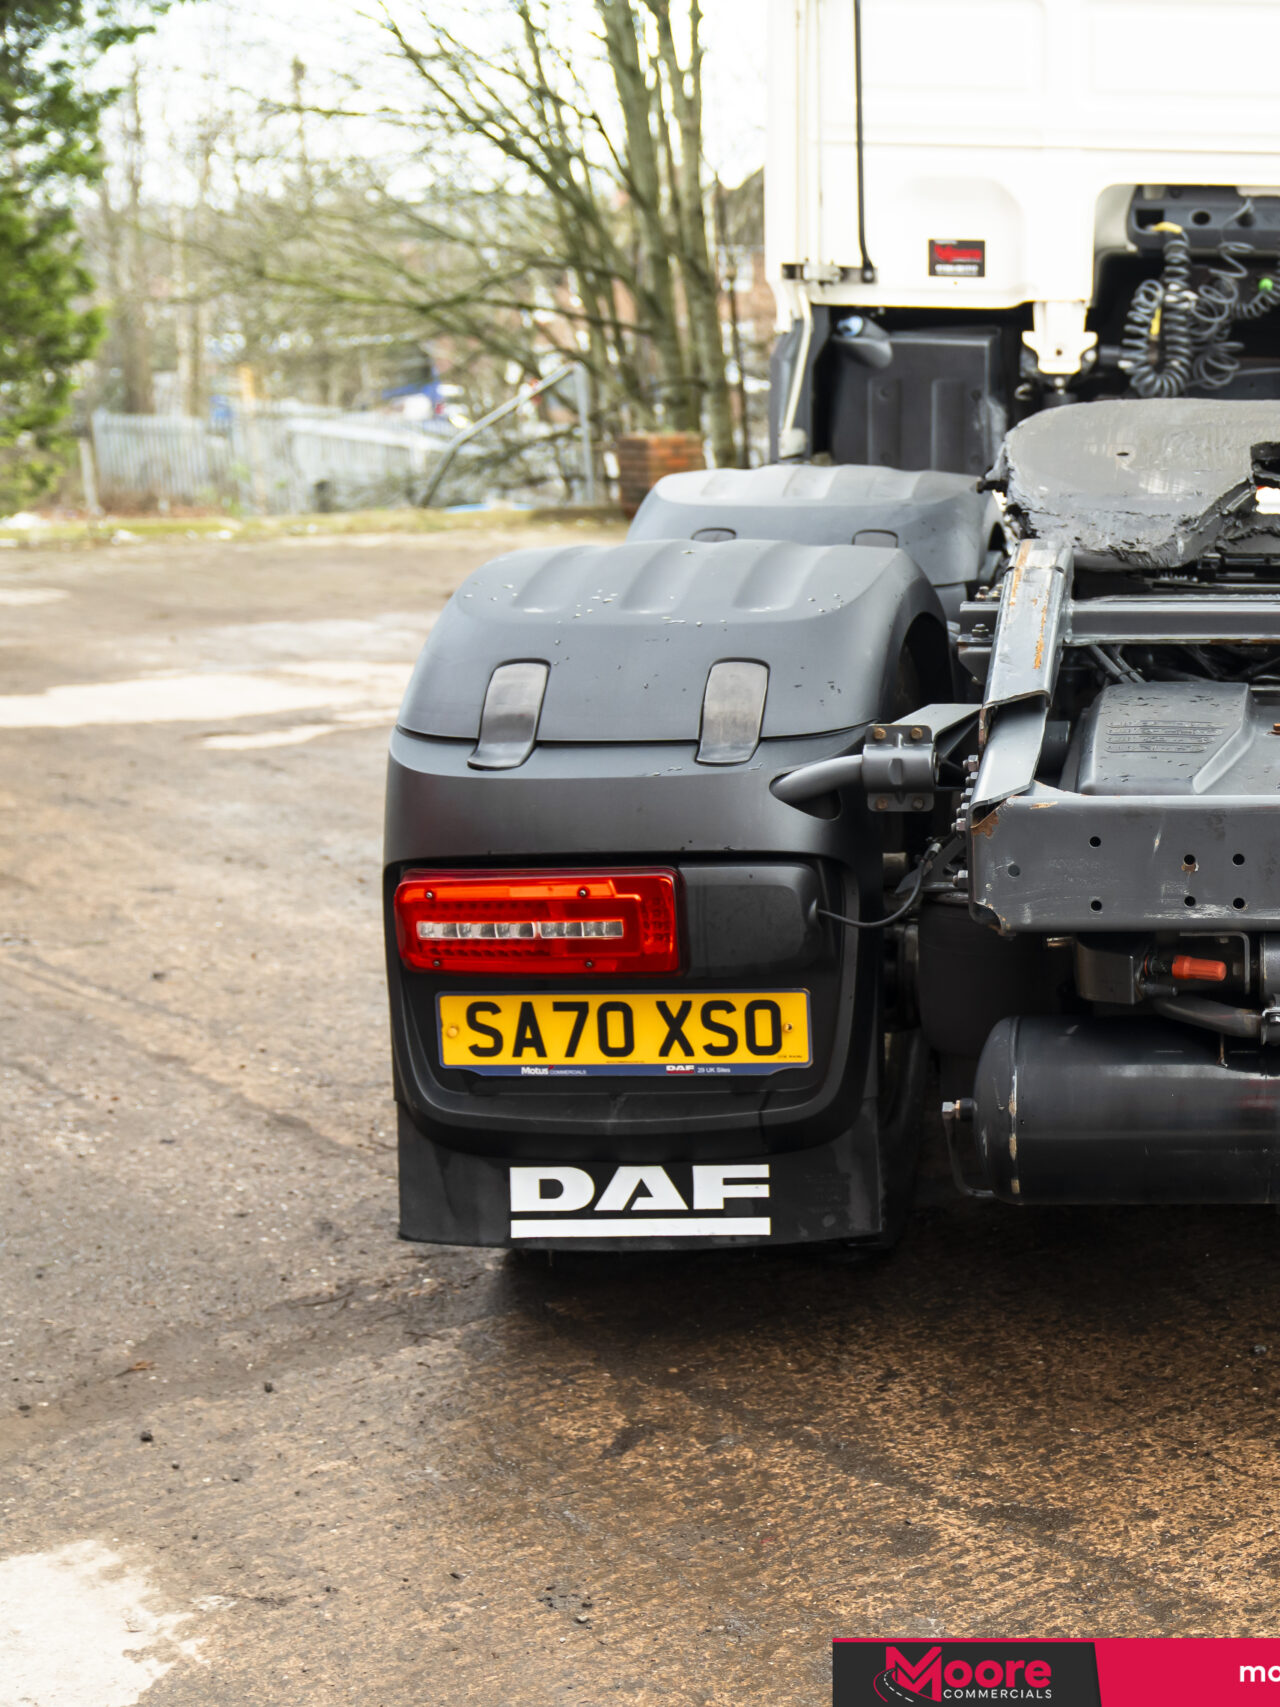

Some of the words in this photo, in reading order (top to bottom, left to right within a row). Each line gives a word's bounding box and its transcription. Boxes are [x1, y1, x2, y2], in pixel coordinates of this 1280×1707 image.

[466, 1001, 635, 1058] SA70
[655, 999, 783, 1057] XSO
[521, 1066, 549, 1075] Motus
[510, 1164, 770, 1212] DAF
